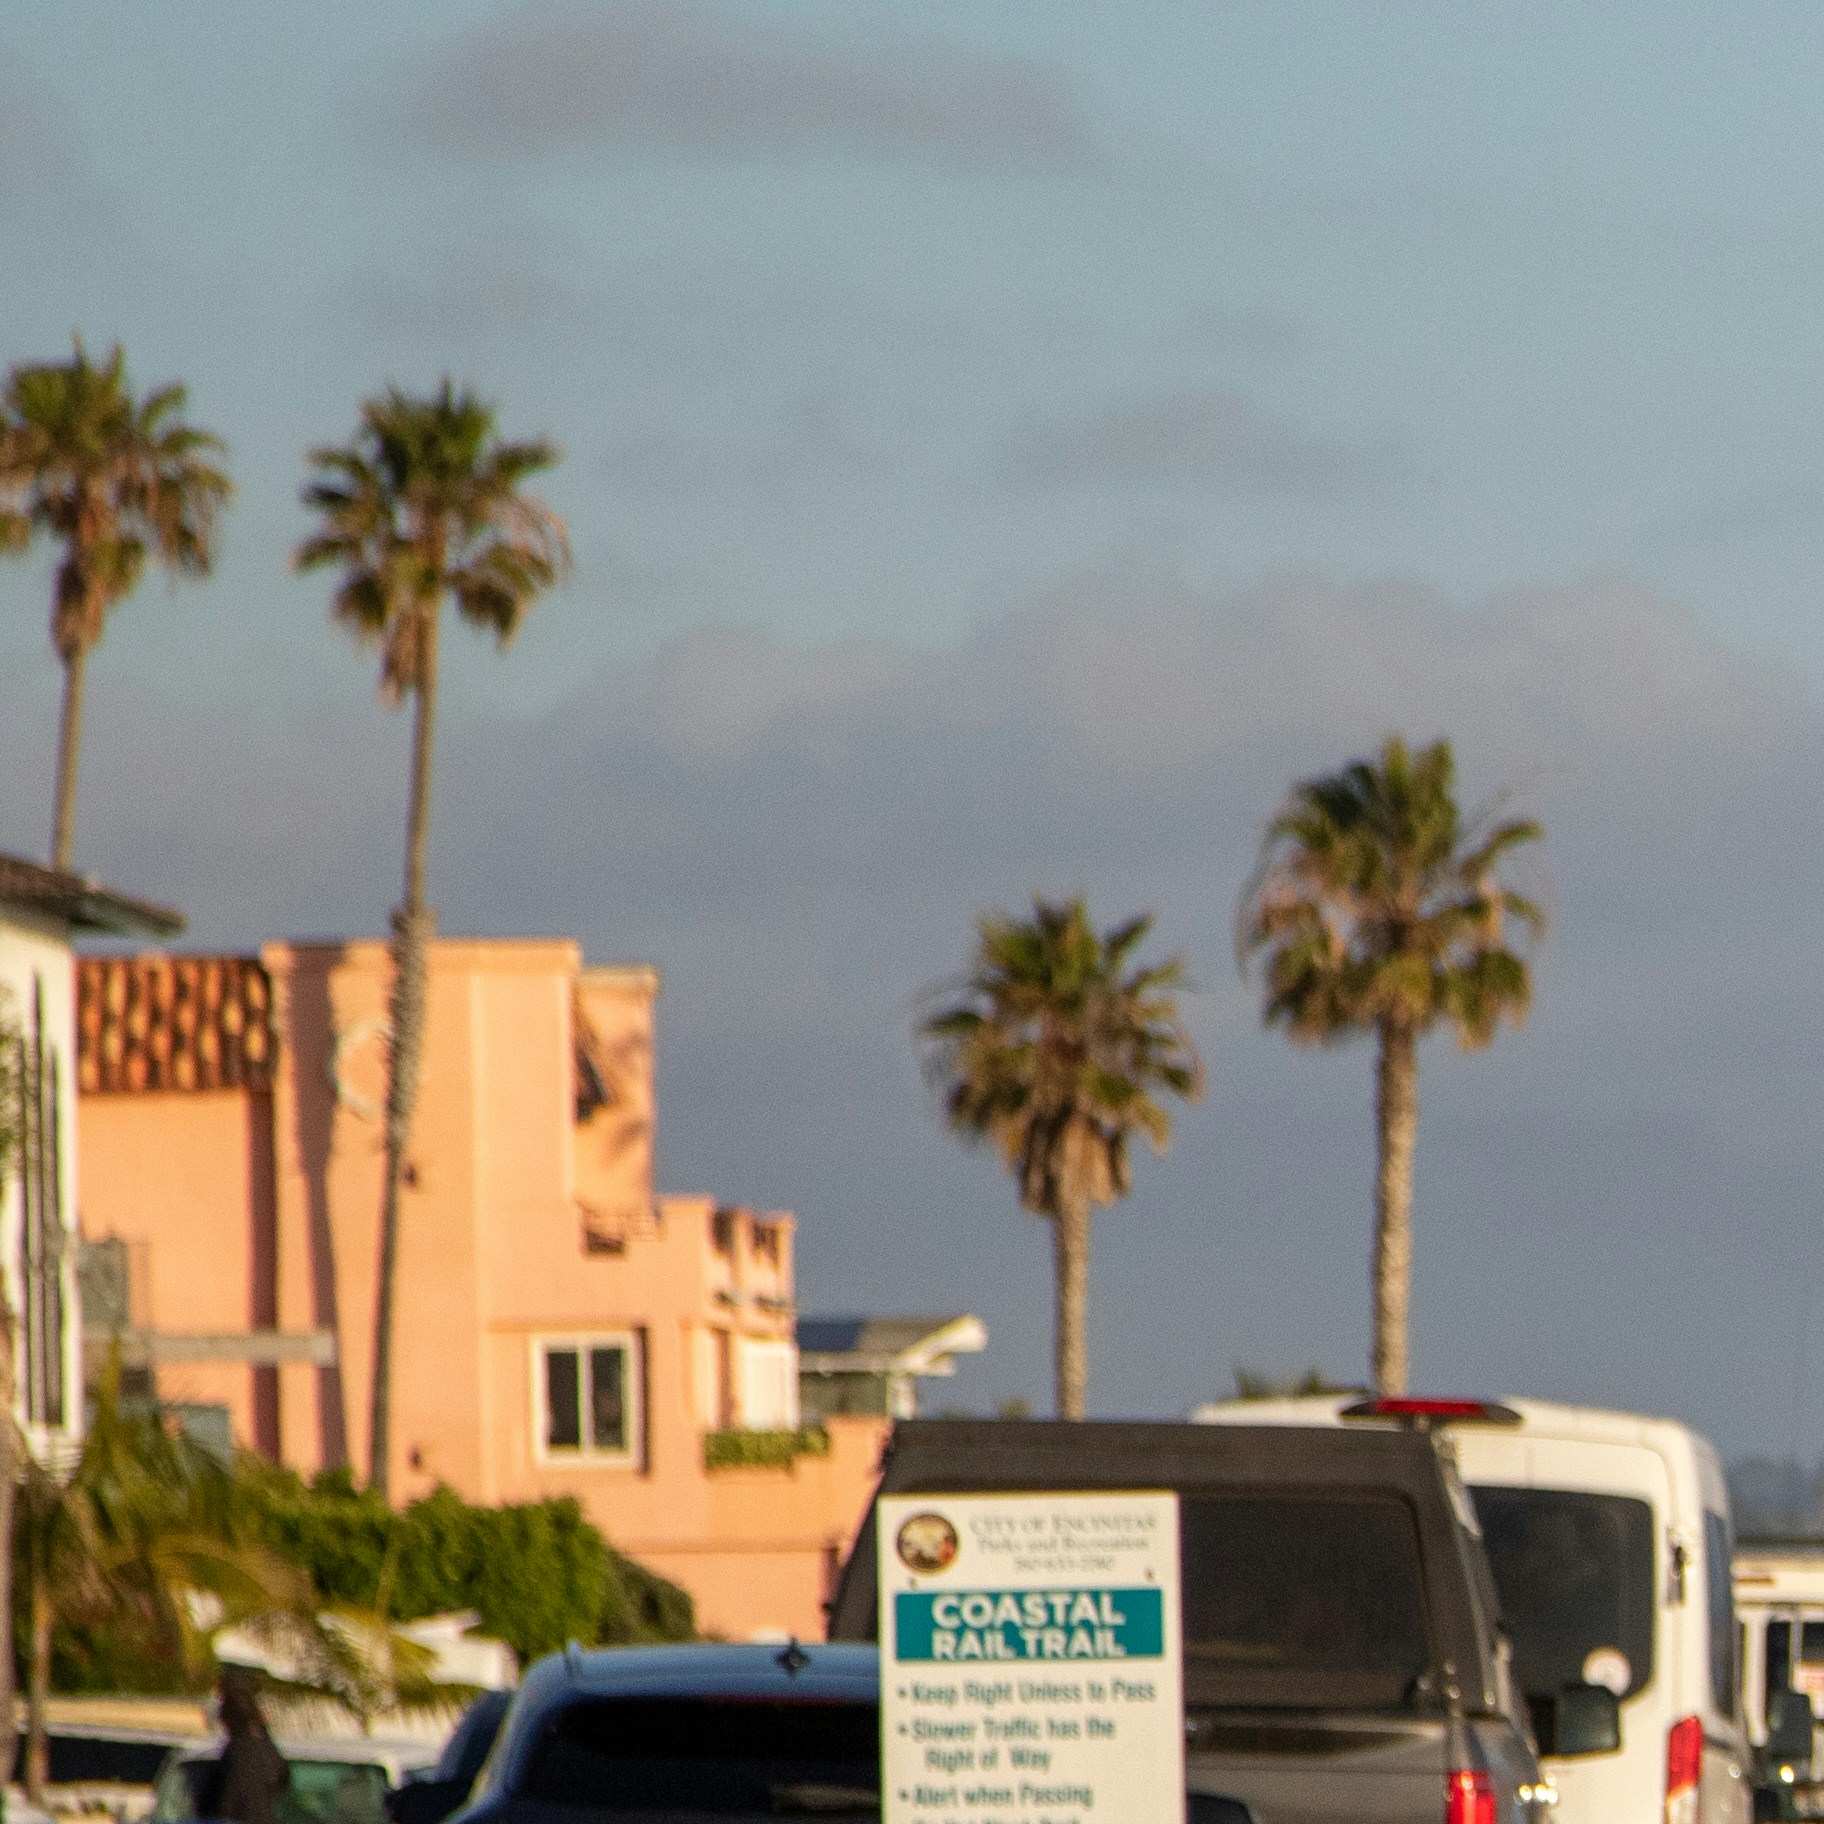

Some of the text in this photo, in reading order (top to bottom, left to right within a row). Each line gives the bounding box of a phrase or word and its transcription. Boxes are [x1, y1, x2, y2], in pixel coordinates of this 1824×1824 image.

[969, 1515, 1015, 1535] CITY
[1021, 1515, 1044, 1533] OF
[977, 1536, 1022, 1553] Parks
[1027, 1535, 1057, 1551] and
[931, 1592, 1126, 1629] COASTAL
[931, 1628, 1126, 1660] RAIL TRAIL
[911, 1677, 1156, 1708] Keep Right Unless to Pass
[912, 1714, 1115, 1742] Slower Traffic has the
[925, 1746, 1052, 1774] Right of Way
[914, 1782, 1094, 1810] Alert when Passing
